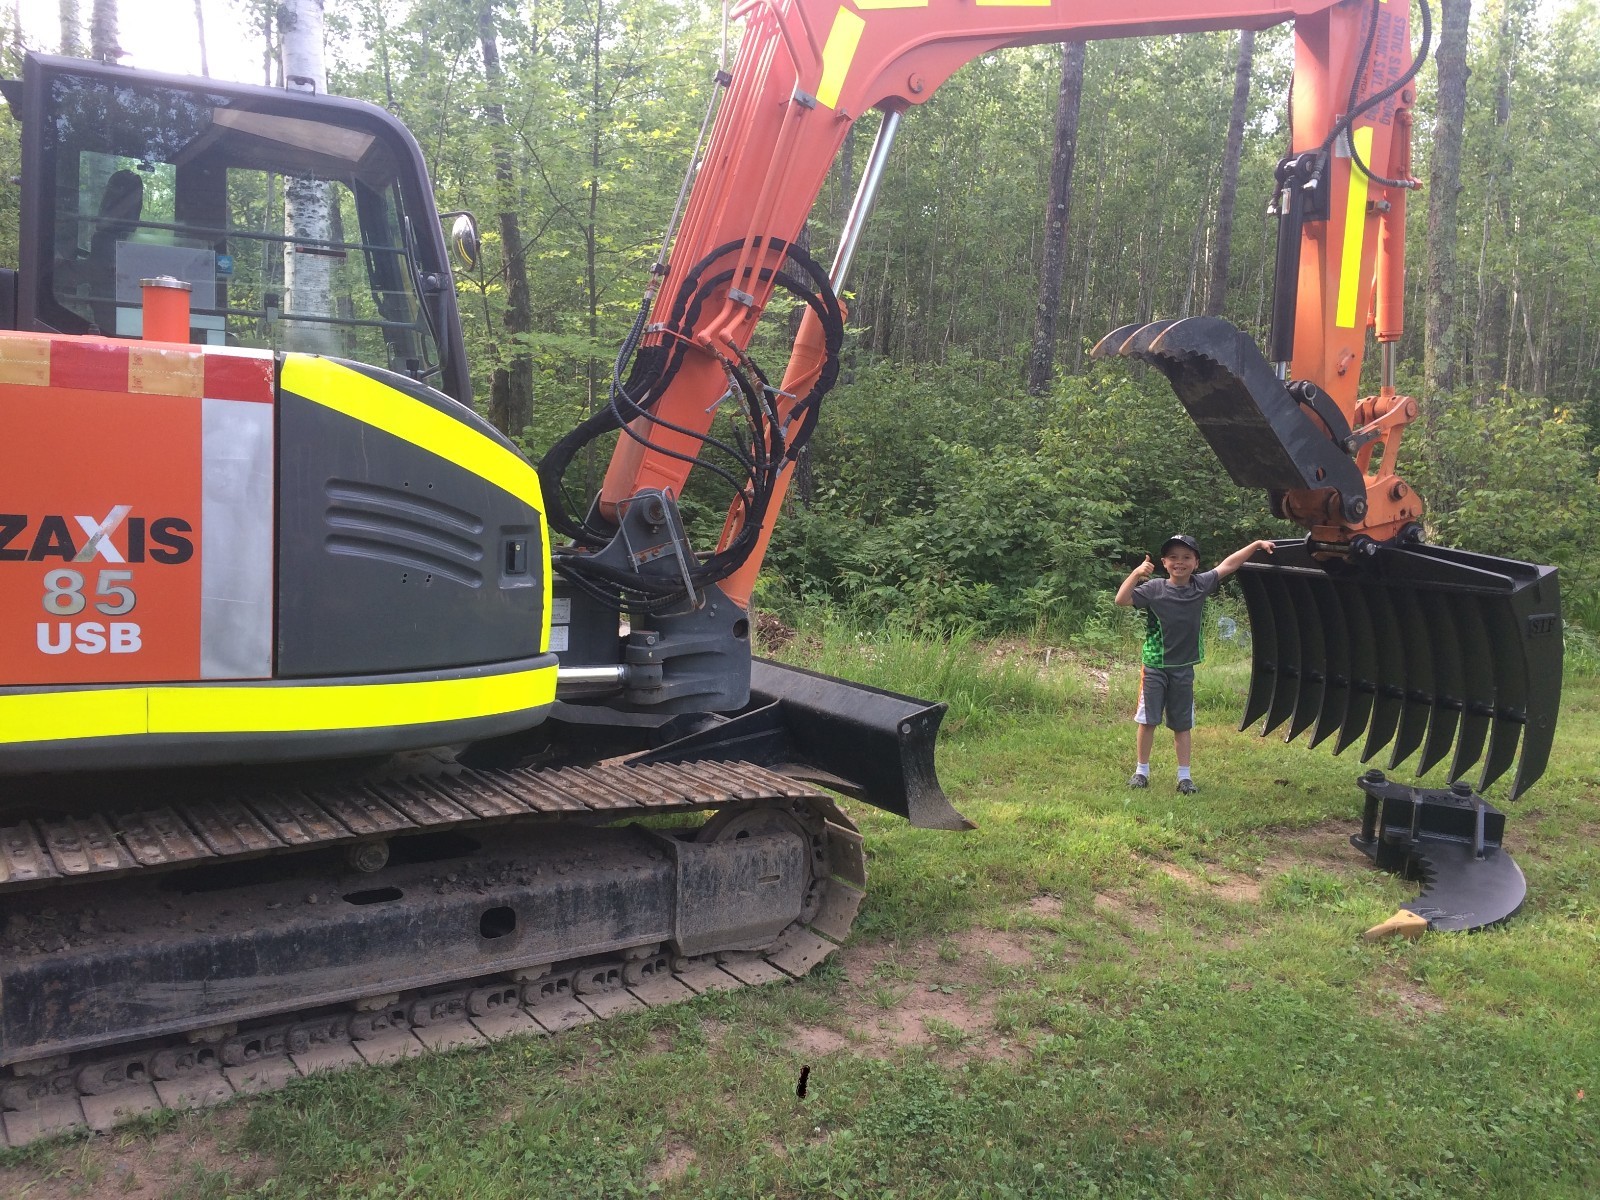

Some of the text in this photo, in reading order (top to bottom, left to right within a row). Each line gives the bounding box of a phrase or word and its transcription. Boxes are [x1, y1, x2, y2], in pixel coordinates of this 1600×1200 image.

[1390, 17, 1406, 52] STATIC
[0, 505, 193, 564] ZAXIS
[42, 568, 136, 616] 85
[37, 621, 142, 654] USB
